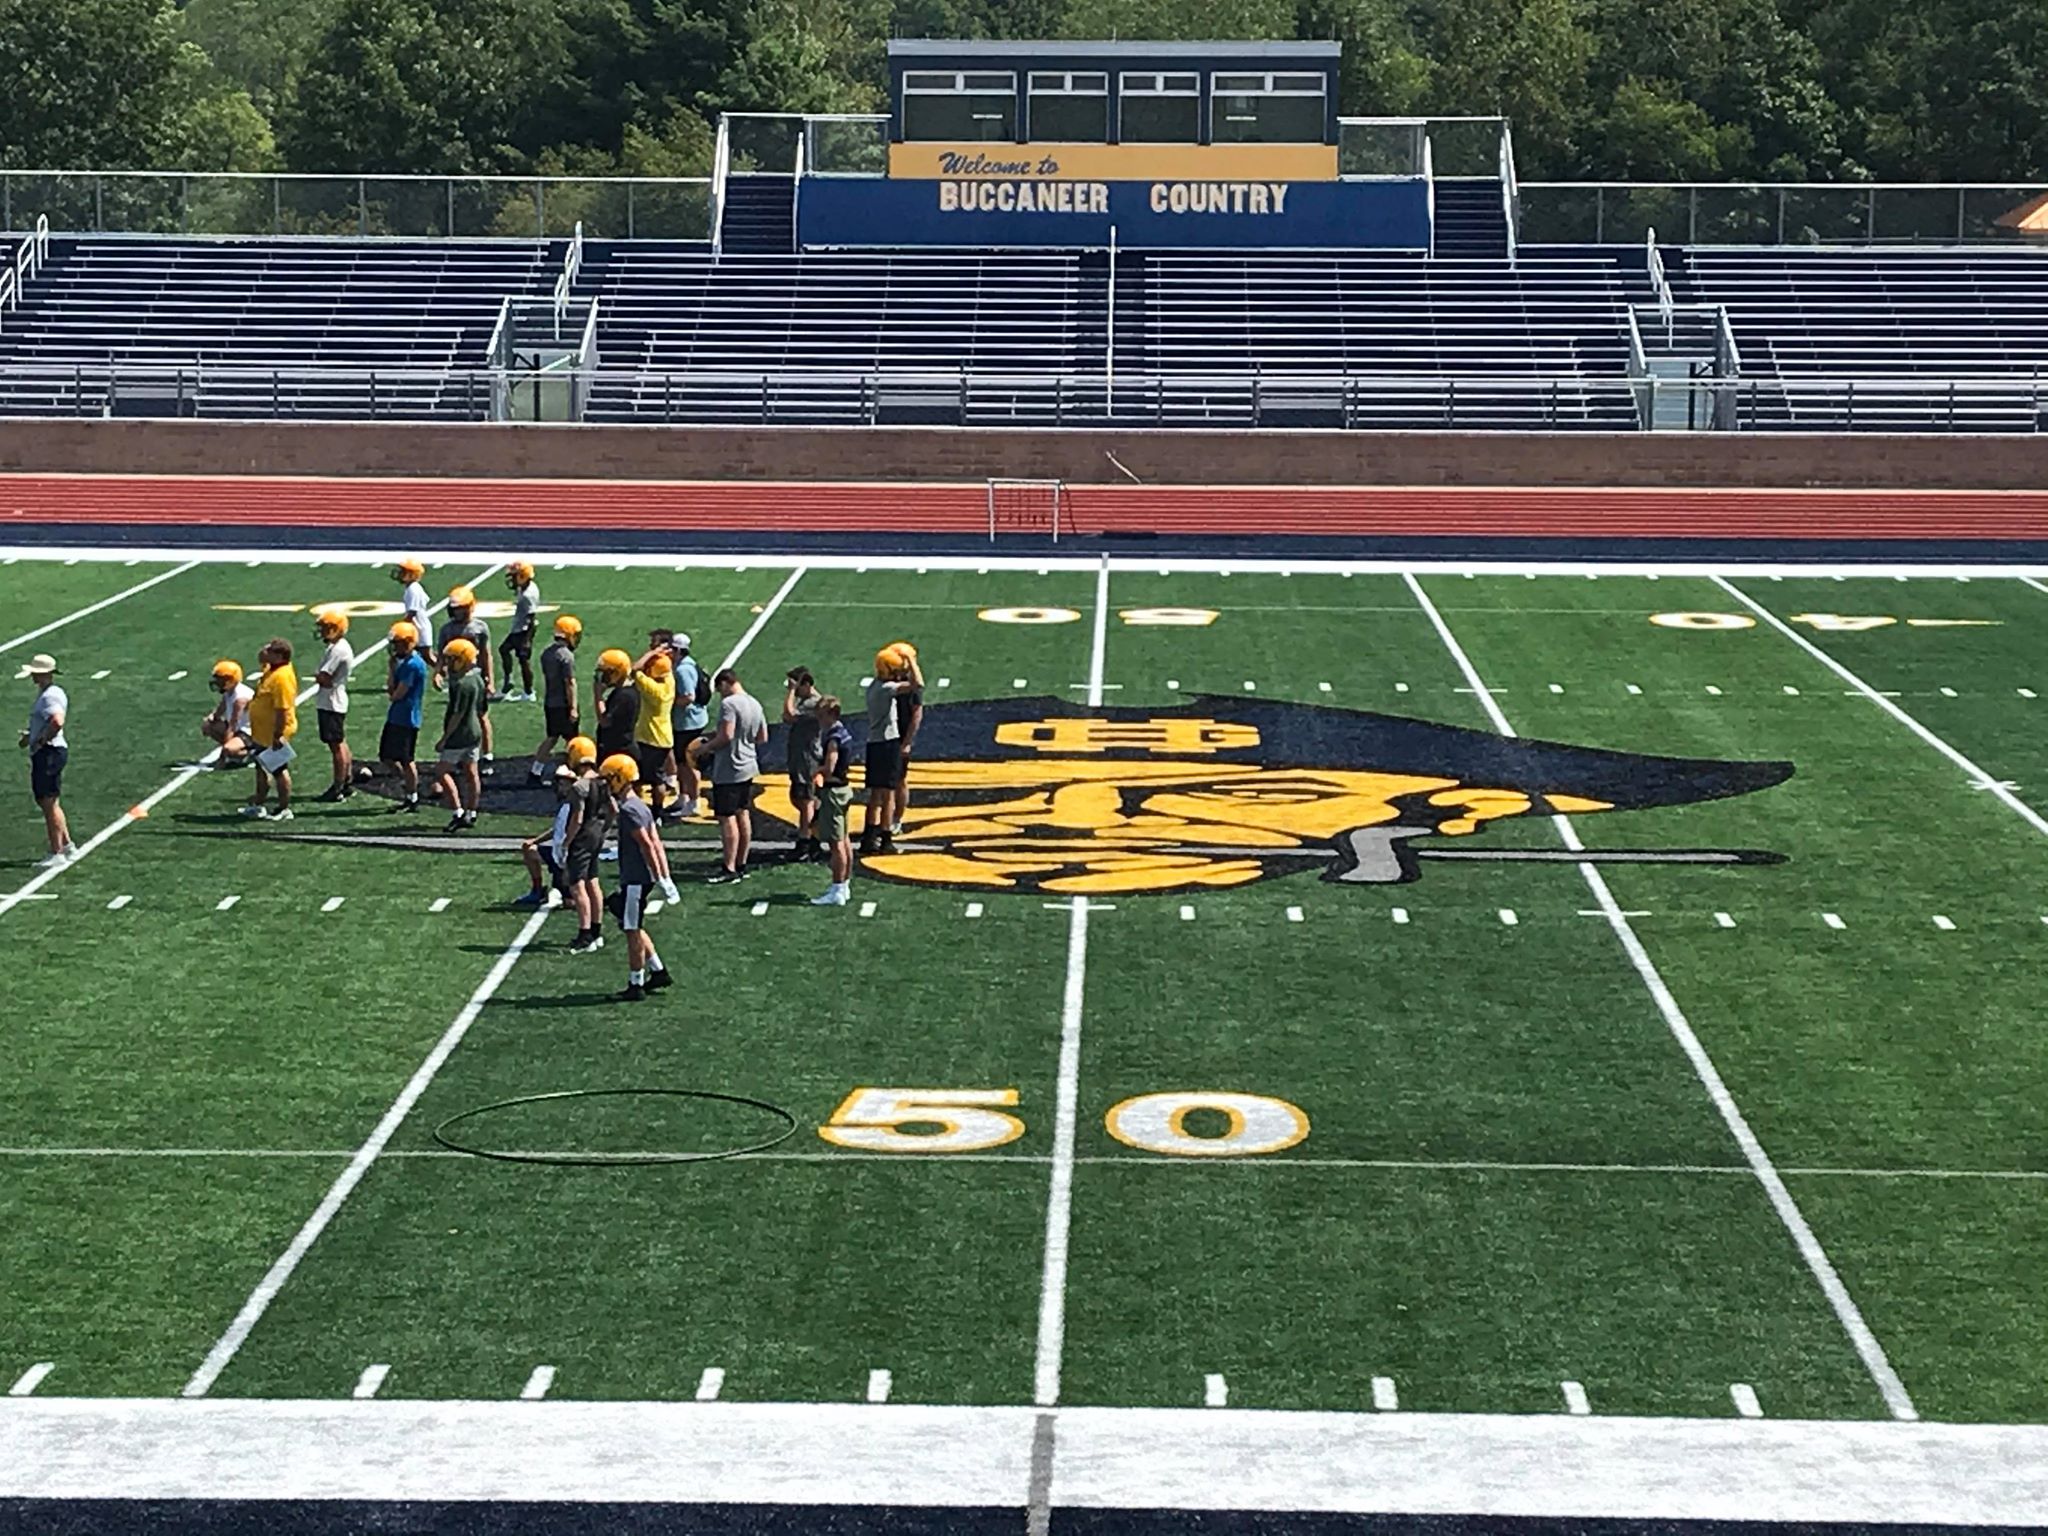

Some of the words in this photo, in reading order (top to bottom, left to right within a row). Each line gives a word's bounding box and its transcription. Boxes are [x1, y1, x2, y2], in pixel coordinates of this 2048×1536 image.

[938, 151, 1031, 175] Welcome
[1036, 154, 1060, 175] to
[939, 181, 1109, 213] BUCCANEER
[1150, 183, 1289, 214] COUNTRY
